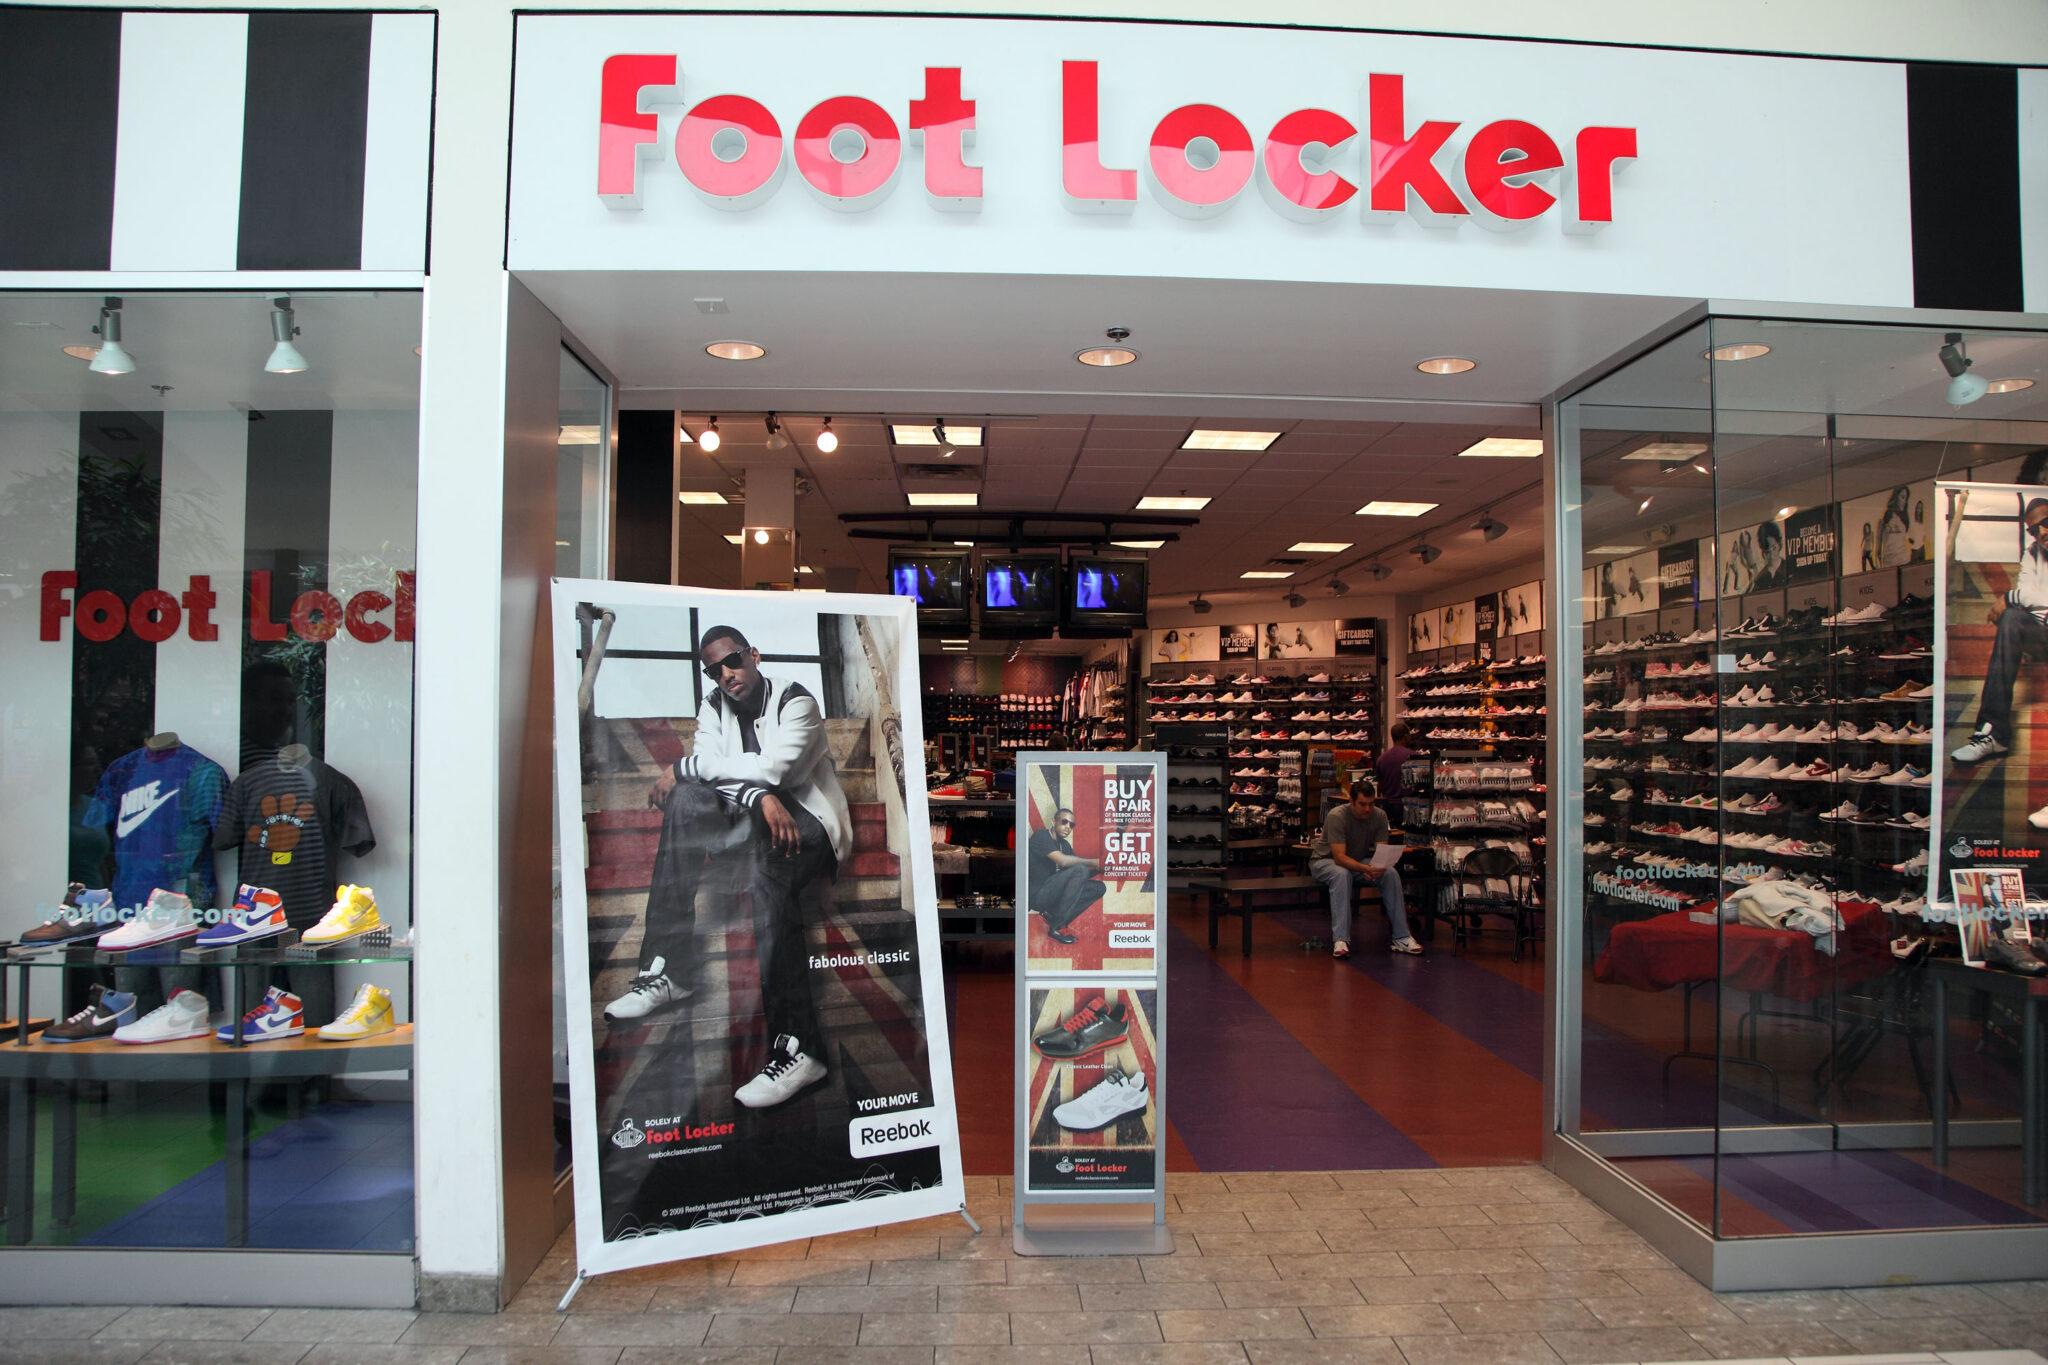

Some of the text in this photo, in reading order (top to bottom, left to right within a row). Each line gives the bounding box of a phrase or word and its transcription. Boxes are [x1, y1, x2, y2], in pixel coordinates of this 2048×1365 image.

[598, 53, 1638, 224] Foot Locker
[1787, 537, 1801, 555] VIP
[1859, 585, 1874, 595] KIDS
[40, 571, 218, 642] Foot
[1105, 779, 1152, 799] BUY
[1105, 800, 1151, 812] A PAIR
[1105, 832, 1151, 852] GET
[1105, 853, 1151, 864] A PAIR
[1974, 846, 2040, 858] Foot Locker
[1593, 875, 1680, 912] footlocker.com
[1114, 934, 1151, 943] Reebok
[809, 949, 910, 969] fabolous classic
[857, 1092, 919, 1111] YOUR MOVE
[645, 1116, 681, 1127] SOLELY AT
[646, 1122, 735, 1144] Foot Locker
[861, 1119, 932, 1145] Reebok
[1075, 1163, 1127, 1172] Foot Locker
[669, 1207, 684, 1216] 2009
[685, 1204, 706, 1213] Reebok
[706, 1198, 740, 1209] International
[708, 1209, 728, 1218] Reebok
